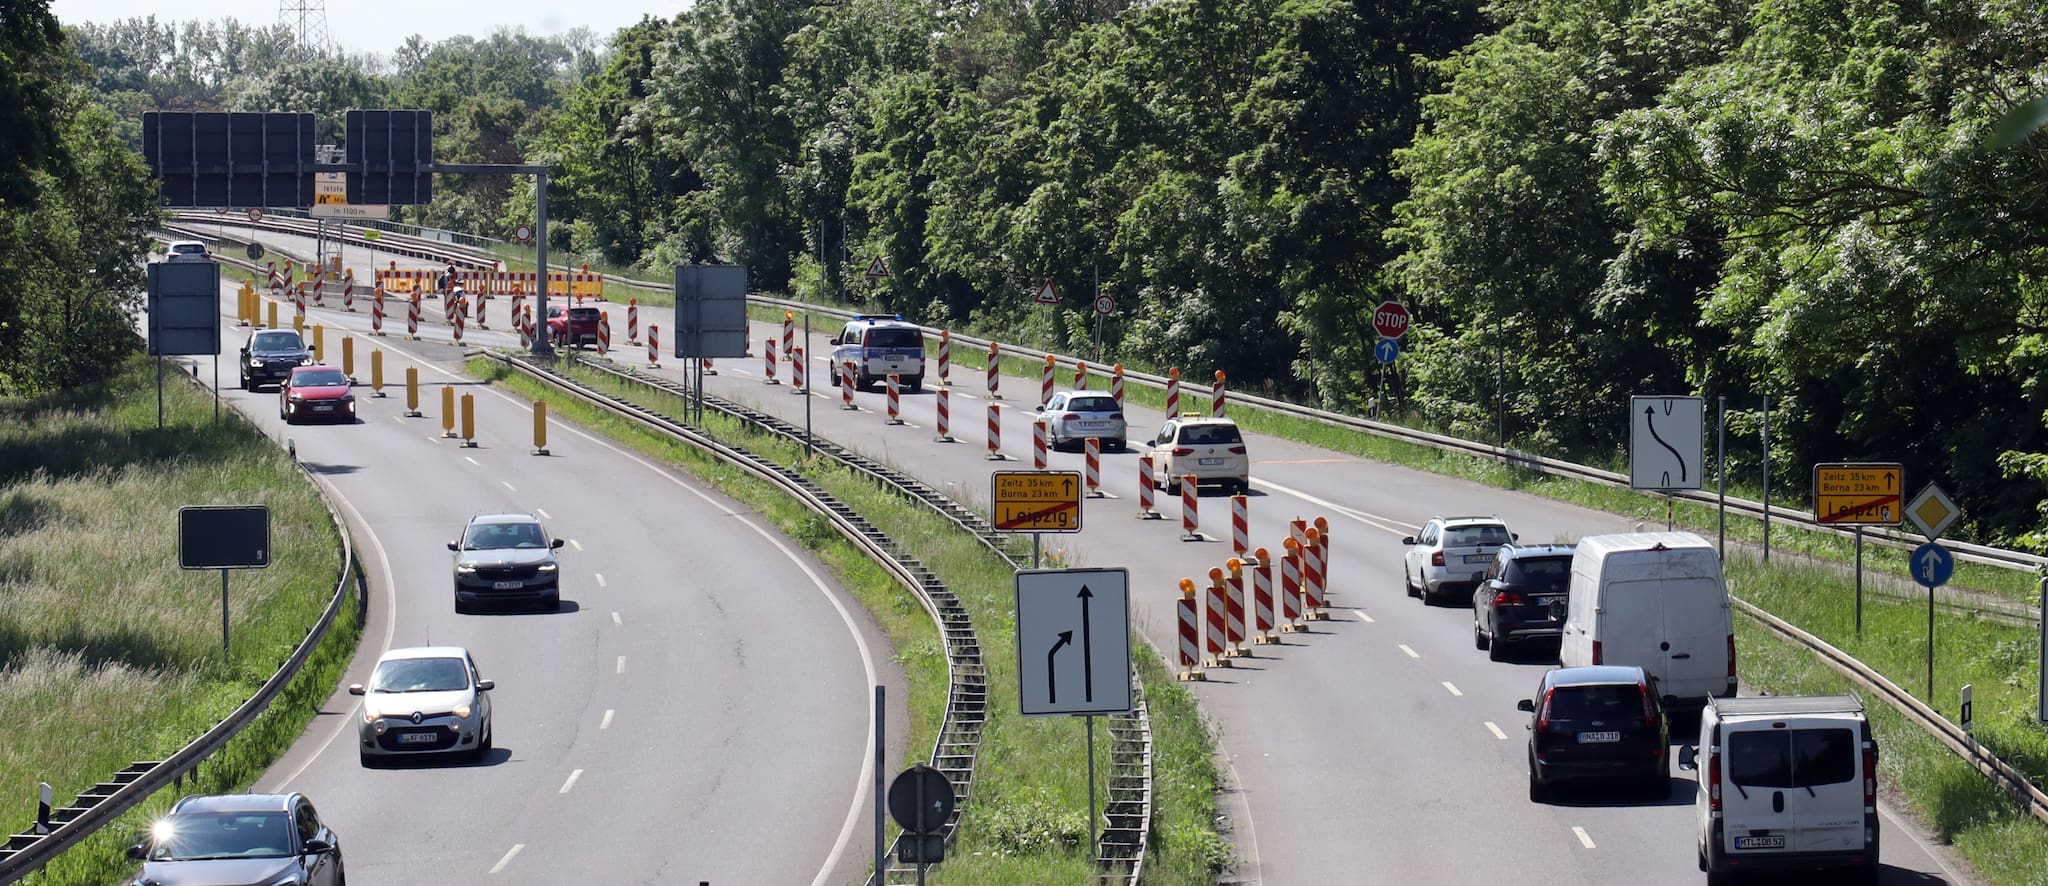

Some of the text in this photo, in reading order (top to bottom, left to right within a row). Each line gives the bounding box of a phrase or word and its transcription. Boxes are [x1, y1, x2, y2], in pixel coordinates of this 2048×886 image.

[1100, 300, 1110, 310] 50
[1376, 311, 1407, 329] STOP
[1823, 472, 1876, 481] Zeitz 35 km
[1001, 478, 1054, 488] Zeitz 35 km
[1823, 483, 1880, 492] Borna 23 km
[1001, 489, 1058, 498] Borna 23 km
[1006, 506, 1068, 527] Leipzig
